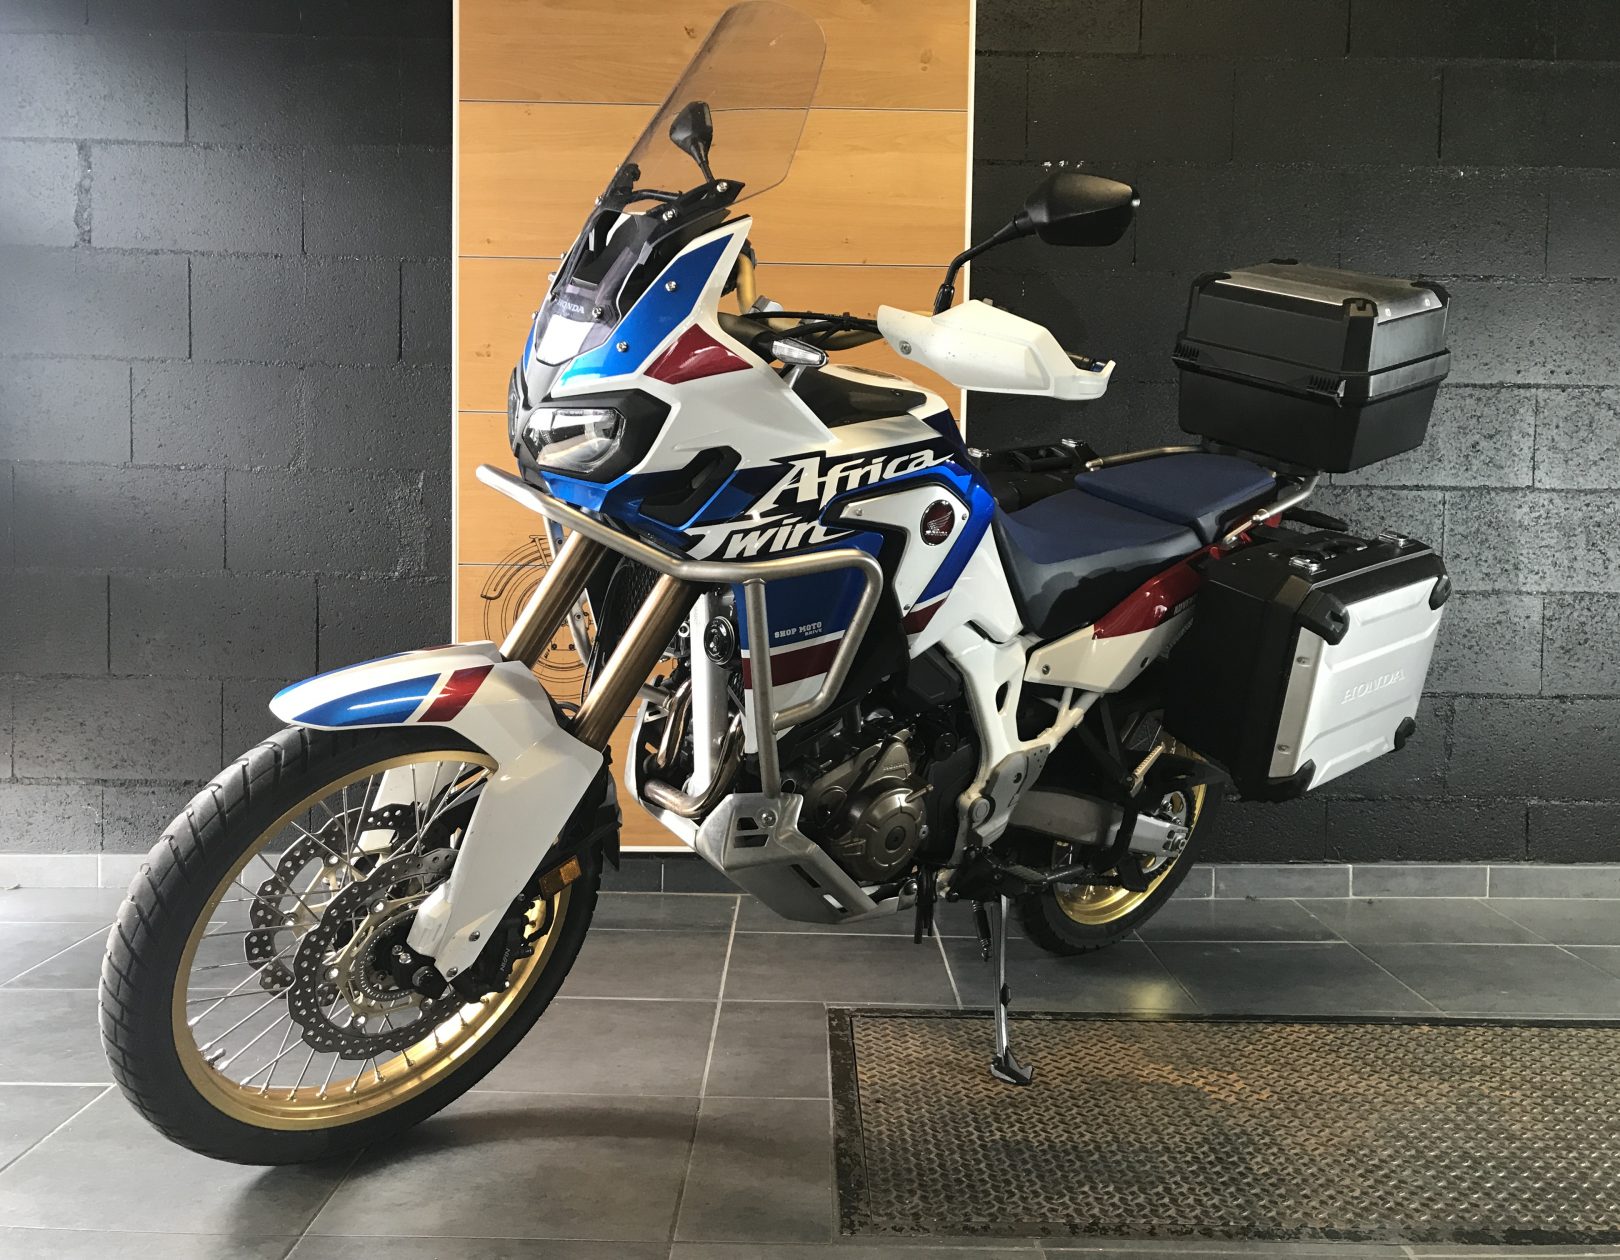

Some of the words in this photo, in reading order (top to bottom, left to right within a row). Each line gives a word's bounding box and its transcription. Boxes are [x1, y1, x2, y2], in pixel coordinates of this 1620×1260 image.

[744, 449, 954, 516] Africa
[682, 513, 856, 560] Twin
[774, 628, 797, 638] SHOP
[799, 621, 822, 633] MOTO
[1340, 669, 1406, 704] HONDA
